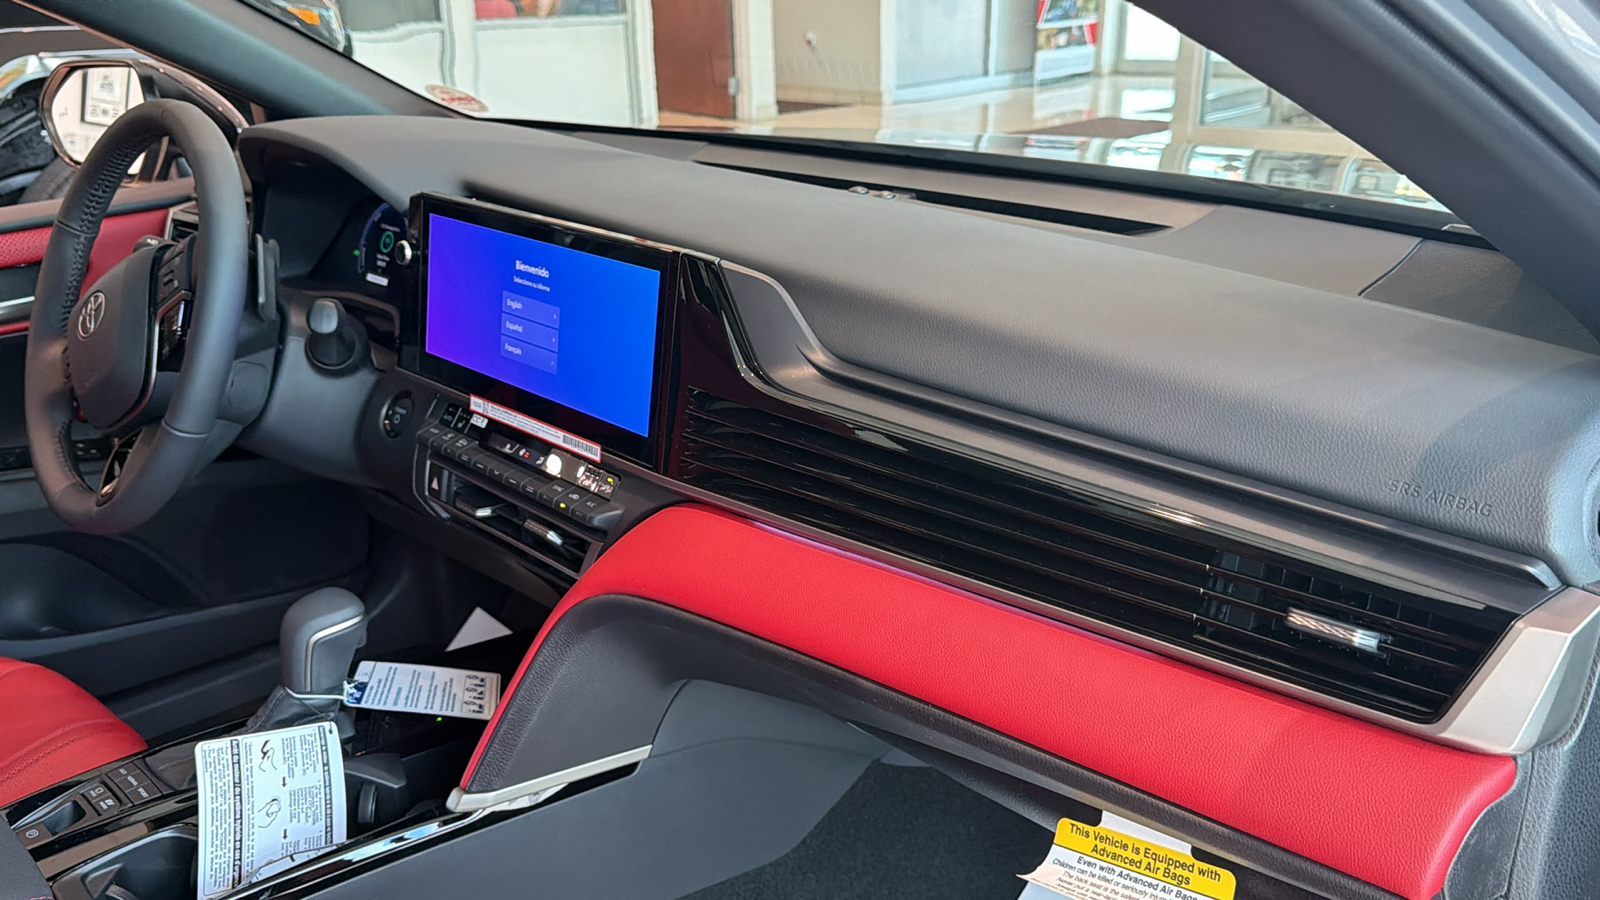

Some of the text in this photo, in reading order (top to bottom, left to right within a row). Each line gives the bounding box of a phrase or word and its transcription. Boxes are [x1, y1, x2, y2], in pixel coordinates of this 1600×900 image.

[515, 259, 550, 278] Bienvenido
[506, 298, 523, 309] English
[505, 320, 523, 333] Español
[504, 343, 522, 355] Français
[1388, 480, 1492, 517] SRS AIRBAG
[1069, 823, 1222, 882] This Vehicle is Equipped with
[1090, 843, 1191, 885] Advanced Air Bags
[1052, 857, 1077, 872] Children
[1076, 868, 1088, 876] can
[1088, 870, 1097, 879] be
[1097, 873, 1114, 884] killed
[1120, 883, 1149, 898] seriously
[1062, 870, 1074, 879] The
[1076, 856, 1098, 870] Even
[1098, 864, 1116, 876] with
[1116, 870, 1159, 890] Advanced
[1159, 885, 1174, 896] Air
